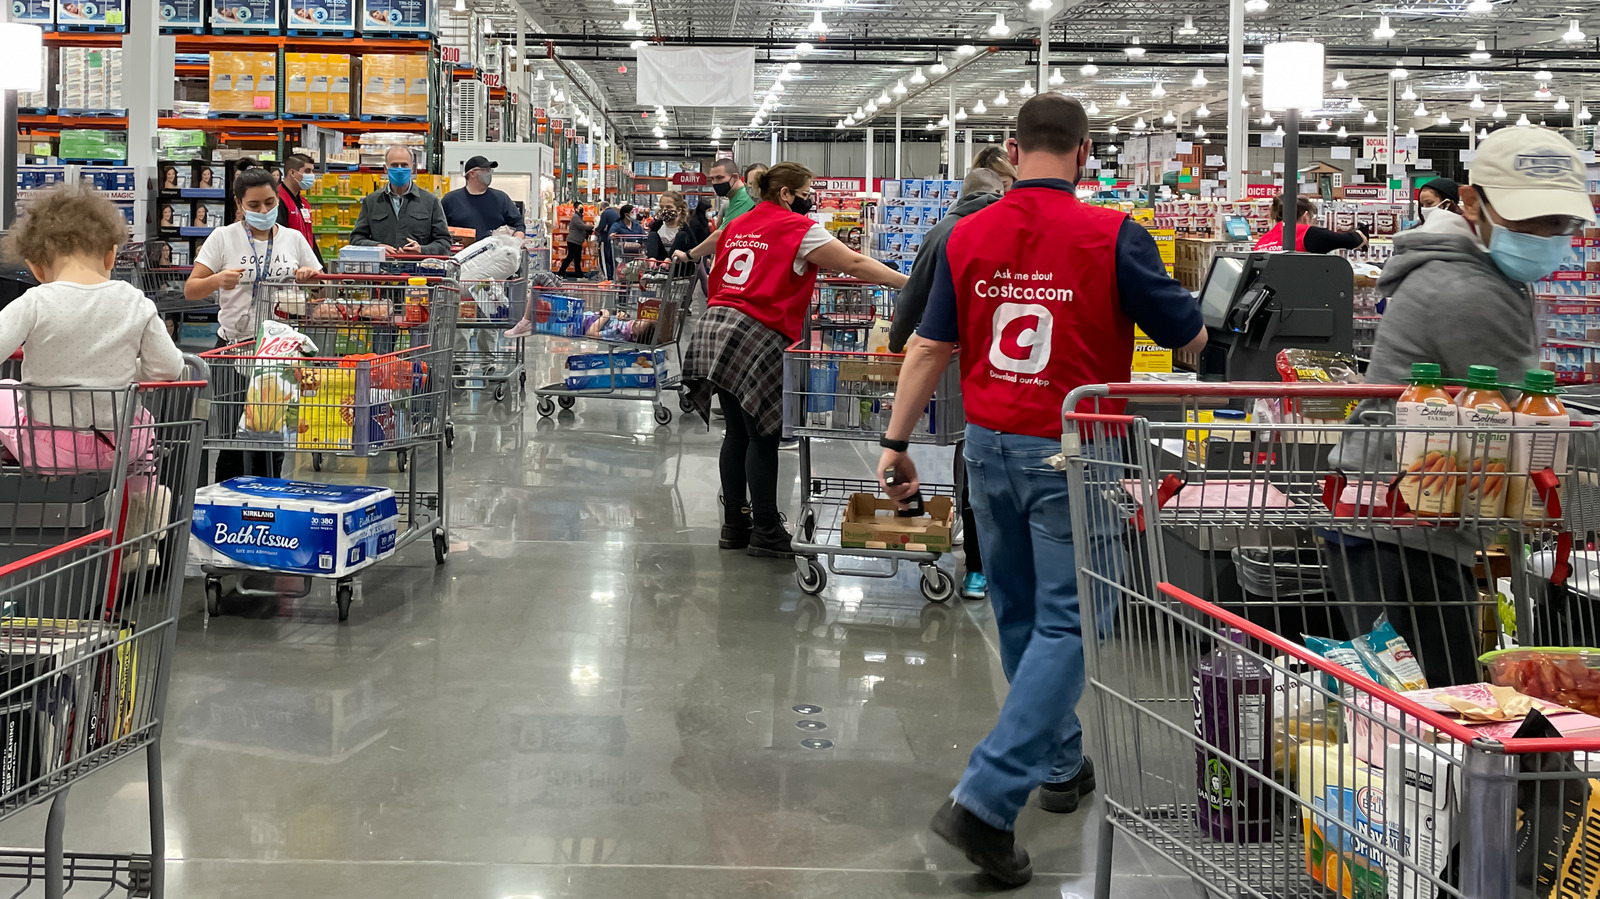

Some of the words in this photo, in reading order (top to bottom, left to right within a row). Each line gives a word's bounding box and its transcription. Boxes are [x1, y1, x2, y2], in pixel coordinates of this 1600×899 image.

[442, 46, 460, 63] 300
[482, 73, 500, 87] 302
[551, 119, 563, 129] 308
[1366, 138, 1385, 146] SOCIAL
[680, 175, 701, 183] DAIRY
[832, 181, 854, 190] DELI
[1247, 187, 1266, 196] OICE
[240, 254, 288, 265] SOCAL
[993, 268, 1012, 280] Ask
[1013, 273, 1029, 281] me
[1031, 270, 1054, 282] about
[974, 279, 1074, 302] Costco.com
[989, 369, 1018, 383] Download
[1018, 377, 1034, 385] our
[1033, 377, 1050, 387] App
[1416, 405, 1456, 417] Bolthouse
[1465, 411, 1509, 425] Bolthouse
[1466, 431, 1507, 443] Orgnics
[243, 510, 274, 519] KIRKLAND
[320, 517, 334, 526] 380
[214, 522, 256, 545] Bath
[255, 525, 300, 550] Tissue
[1389, 836, 1411, 858] MIK
